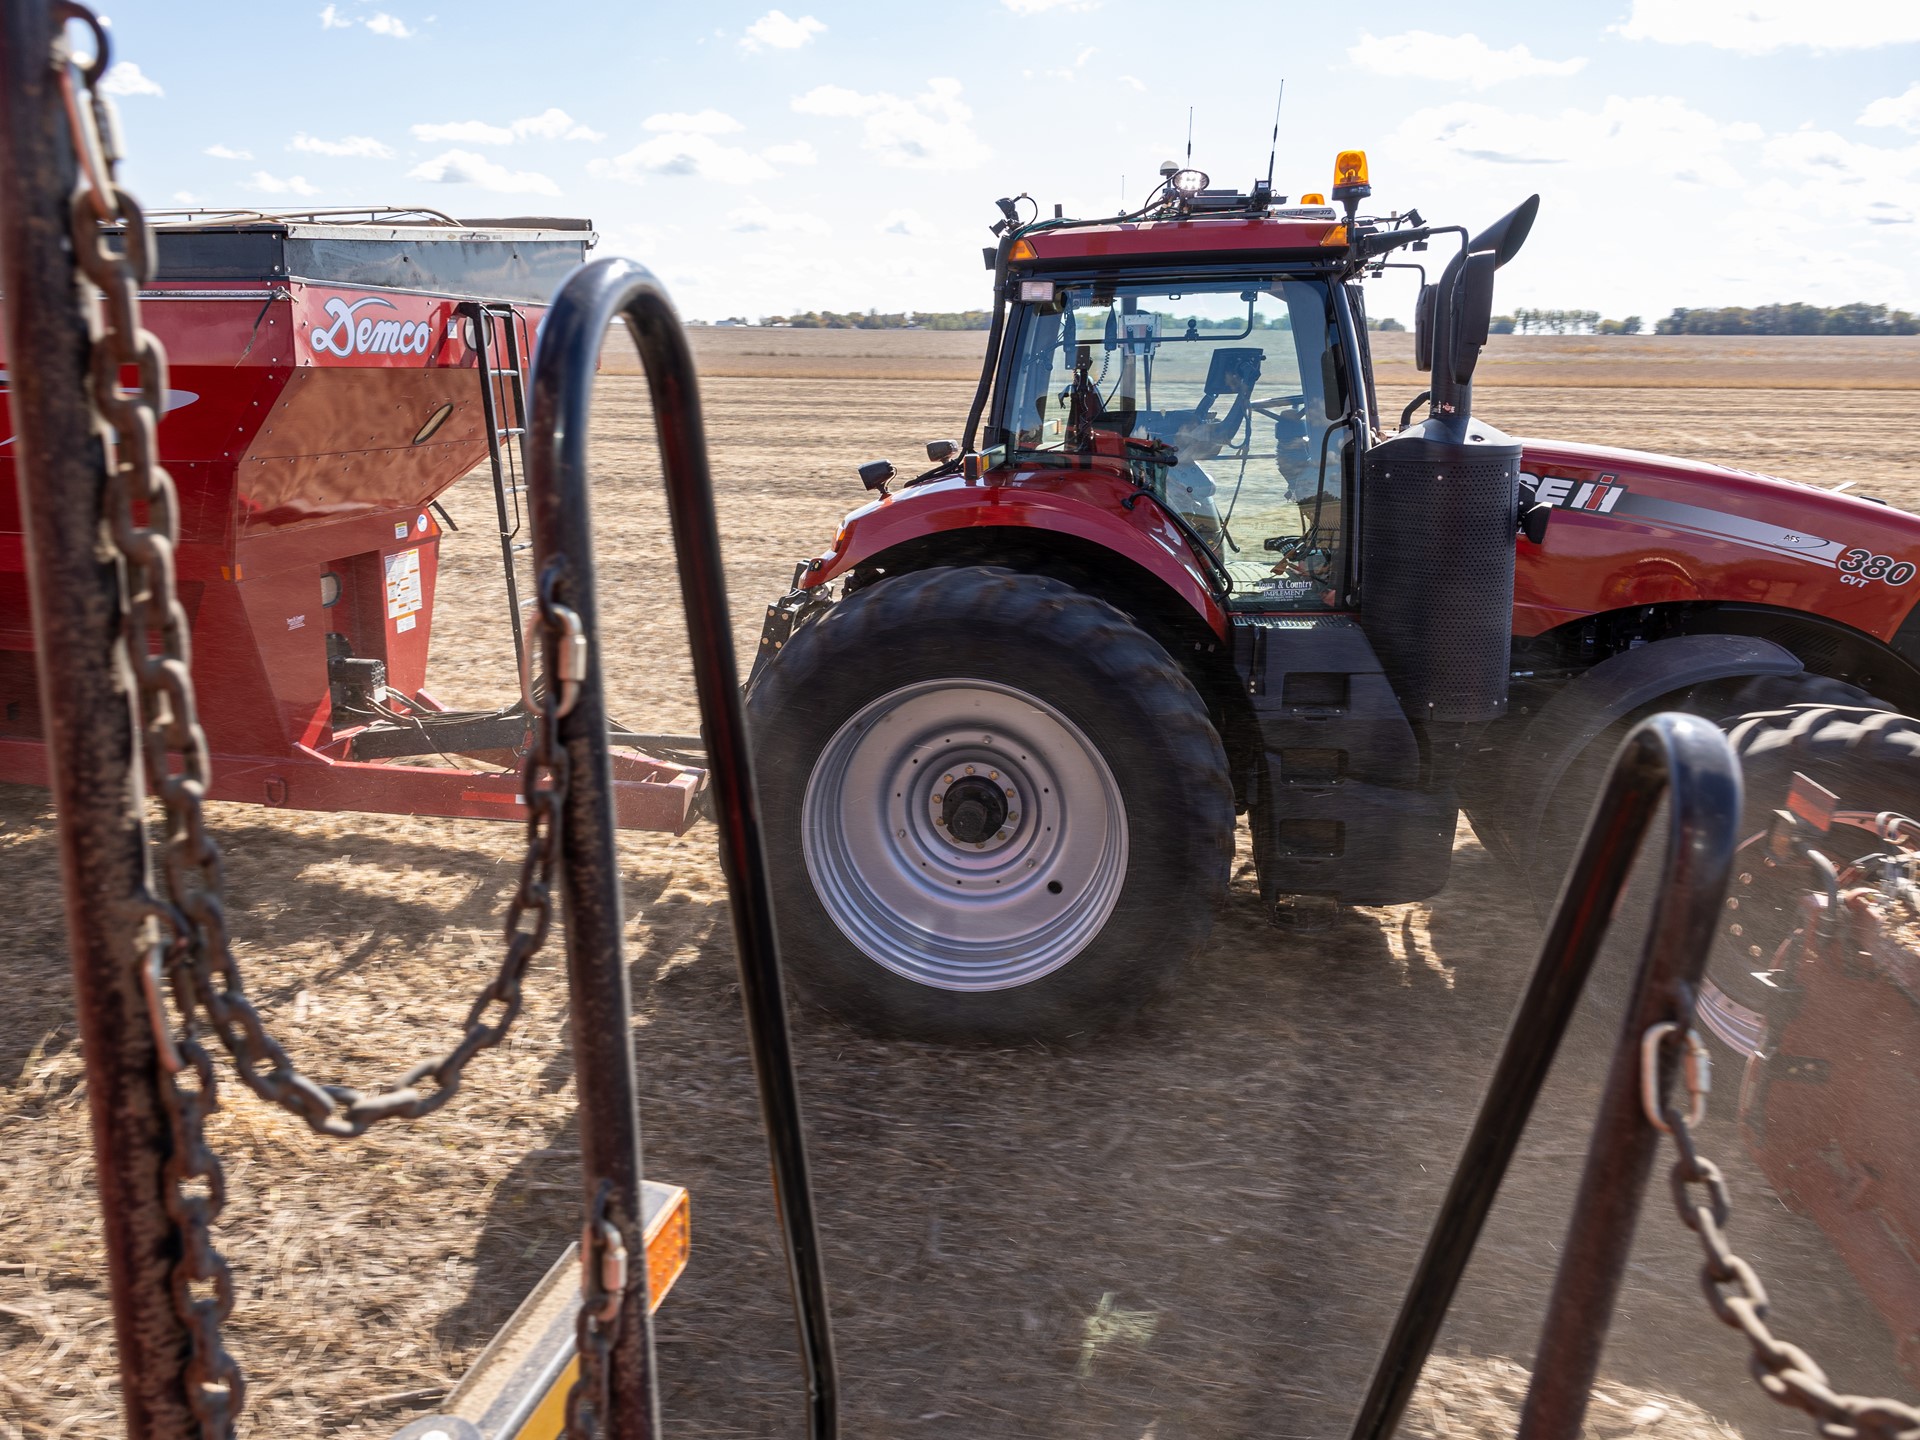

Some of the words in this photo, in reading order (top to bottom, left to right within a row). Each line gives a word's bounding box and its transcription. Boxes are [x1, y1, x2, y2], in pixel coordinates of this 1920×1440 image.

[310, 297, 429, 359] Demco
[1783, 534, 1800, 544] AFS
[1838, 548, 1917, 587] 380
[1258, 581, 1276, 590] Town
[1277, 580, 1284, 589] &
[1285, 579, 1313, 589] Country
[1839, 574, 1870, 588] CVT
